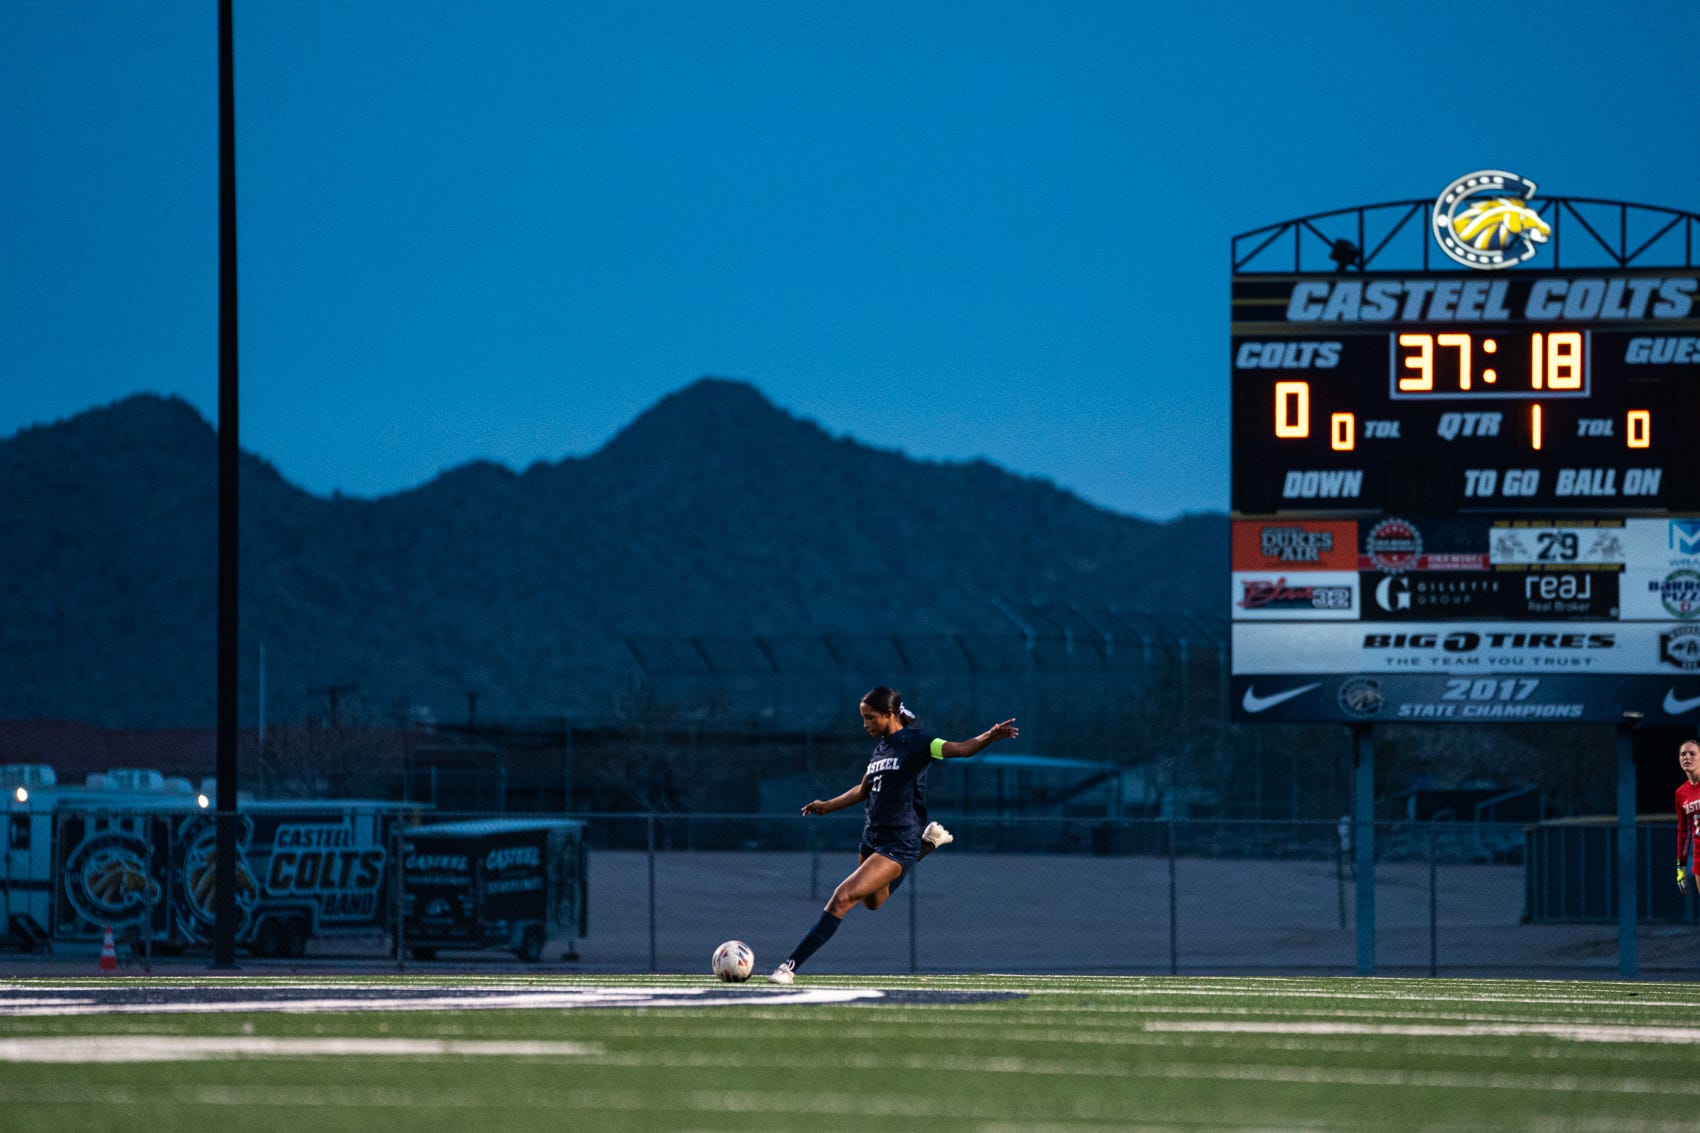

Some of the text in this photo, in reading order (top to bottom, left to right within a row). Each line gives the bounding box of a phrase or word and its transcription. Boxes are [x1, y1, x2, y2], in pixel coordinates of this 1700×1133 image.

[1286, 277, 1699, 322] CASTEEL COLTS
[1235, 341, 1343, 369] COLTS
[1275, 381, 1310, 438] 0
[1331, 412, 1355, 451] 0
[1364, 420, 1401, 438] TOL
[1437, 411, 1503, 441] QTR
[1531, 403, 1542, 450] 1
[1576, 418, 1614, 437] TOL
[1627, 410, 1650, 448] 0
[1282, 470, 1364, 498] DOWN
[1464, 469, 1541, 497] TO GO
[1554, 467, 1663, 497] BALL ON
[1262, 532, 1333, 551] DUKES
[1280, 547, 1320, 561] AIR
[1537, 532, 1580, 561] 29
[1312, 589, 1350, 608] 32
[1376, 575, 1411, 612] G
[1417, 581, 1500, 592] GILLETTE
[1525, 574, 1592, 599] real
[1661, 592, 1700, 601] PIZZ
[1417, 595, 1472, 604] GROUP
[1362, 634, 1438, 649] BIG
[1485, 633, 1616, 649] TIRES
[1386, 657, 1593, 666] THE TEAM YOU TRUST
[1442, 680, 1539, 701] 2017
[1398, 703, 1584, 718] STATE CHAMPIONS
[278, 829, 352, 848] CASTEEL
[267, 850, 385, 891] COLTS
